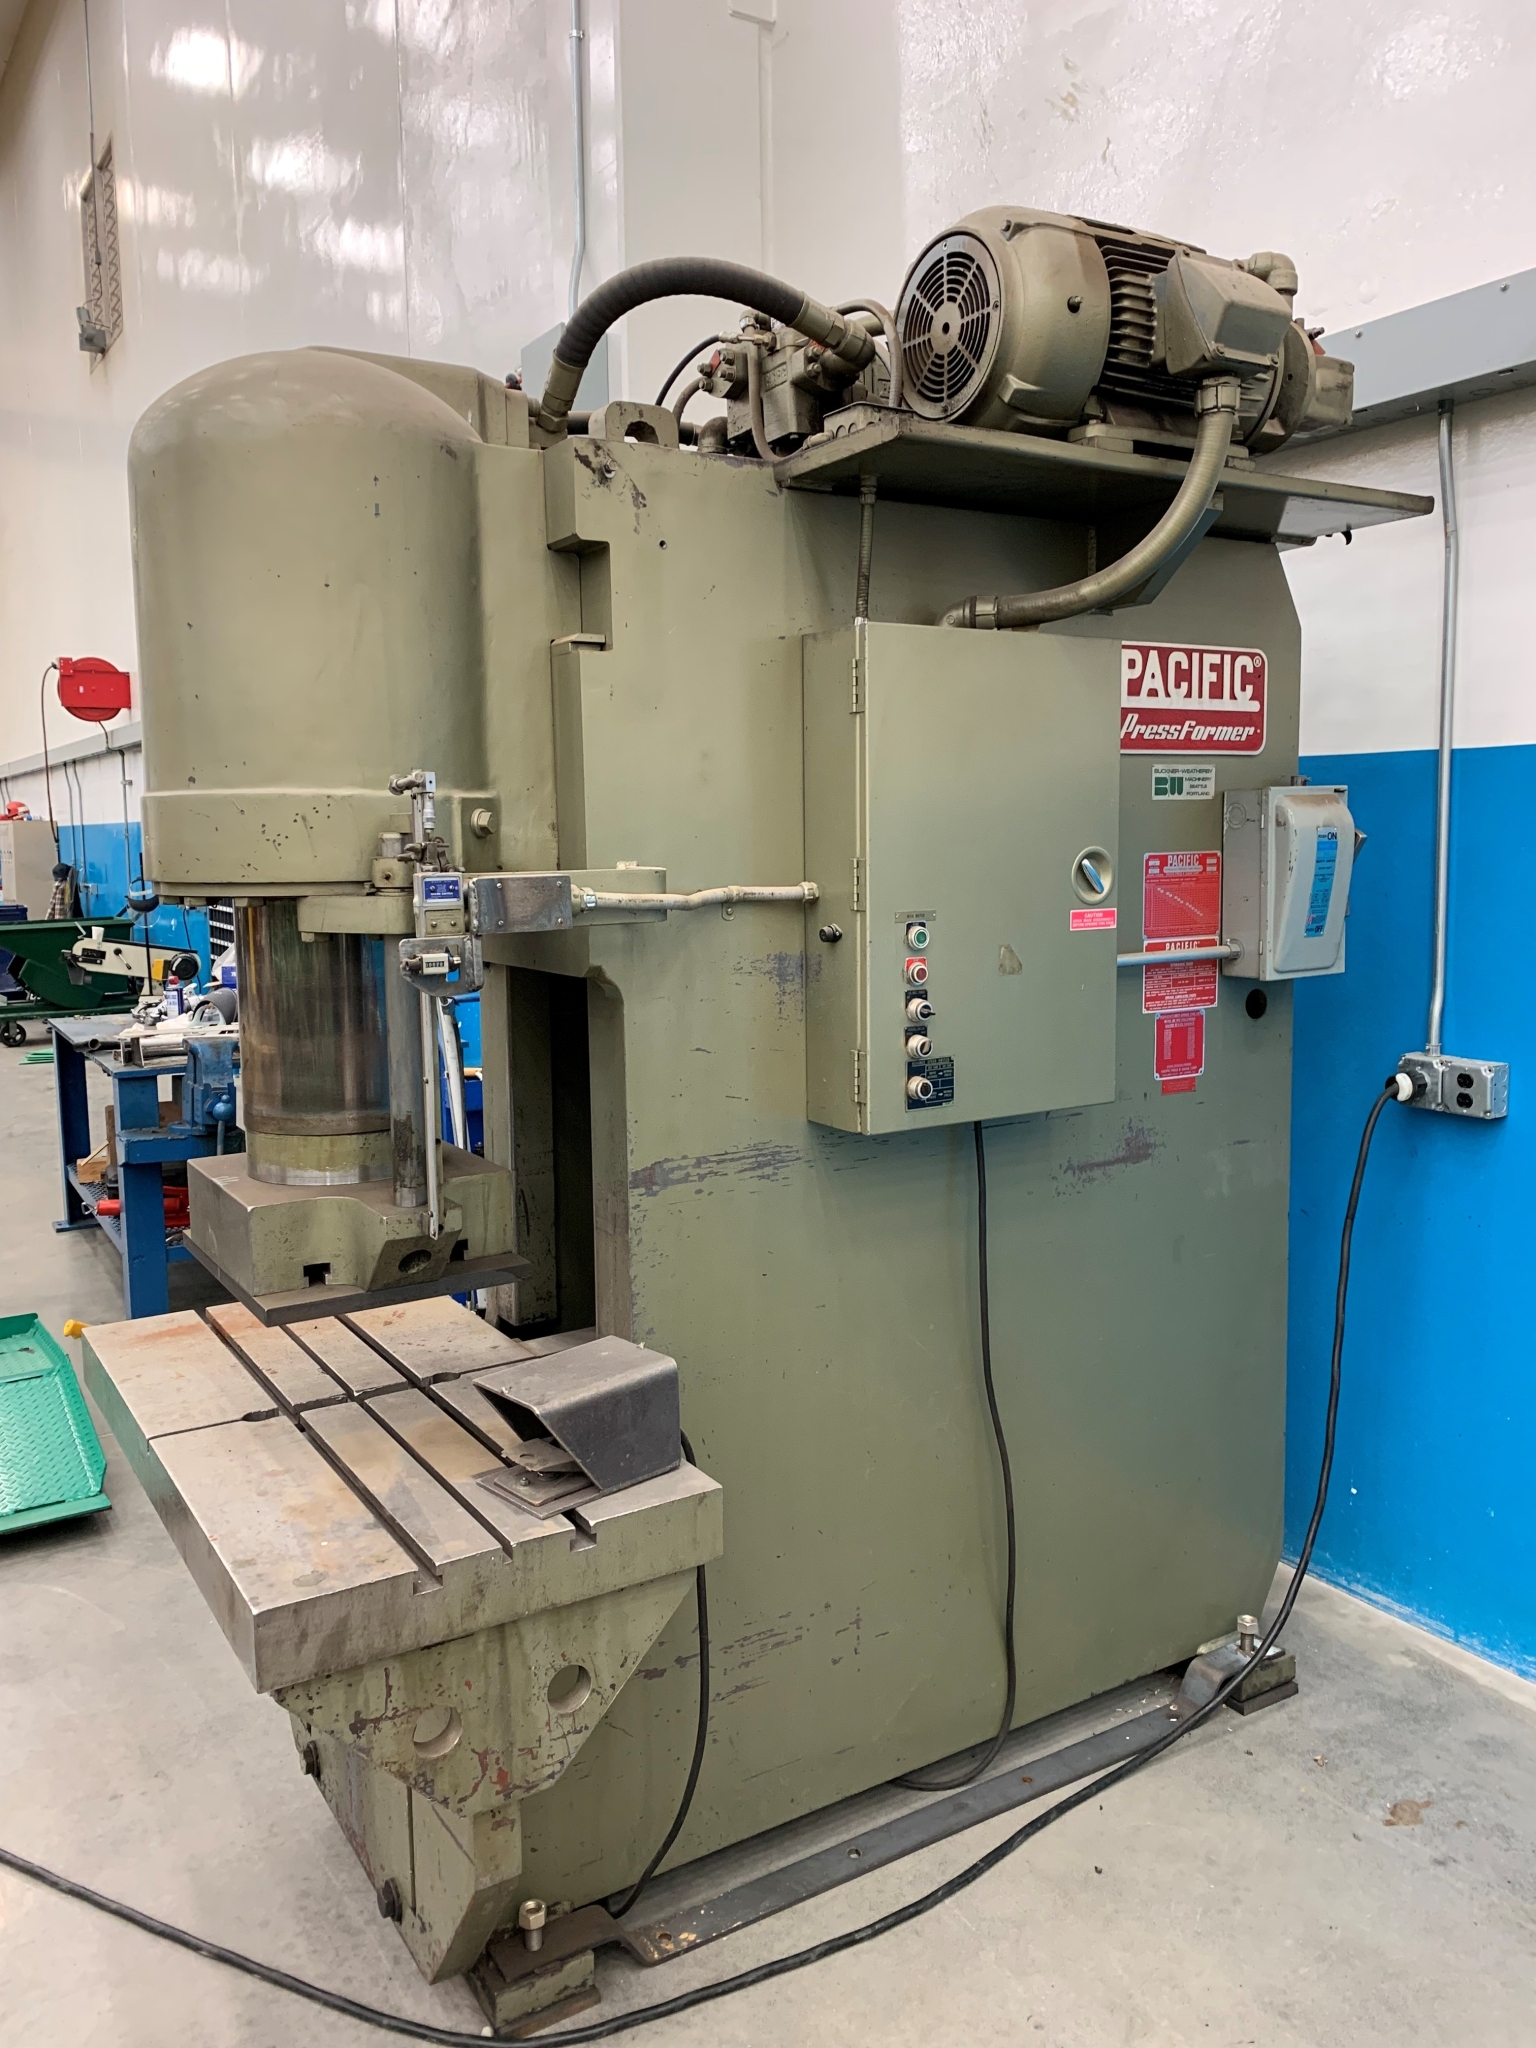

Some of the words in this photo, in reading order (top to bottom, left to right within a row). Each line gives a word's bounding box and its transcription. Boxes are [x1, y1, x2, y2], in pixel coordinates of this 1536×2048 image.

[1121, 713, 1254, 742] PressFormer
[1327, 831, 1337, 840] ON
[1167, 854, 1200, 867] PACIFIC
[1314, 924, 1323, 933] OFF
